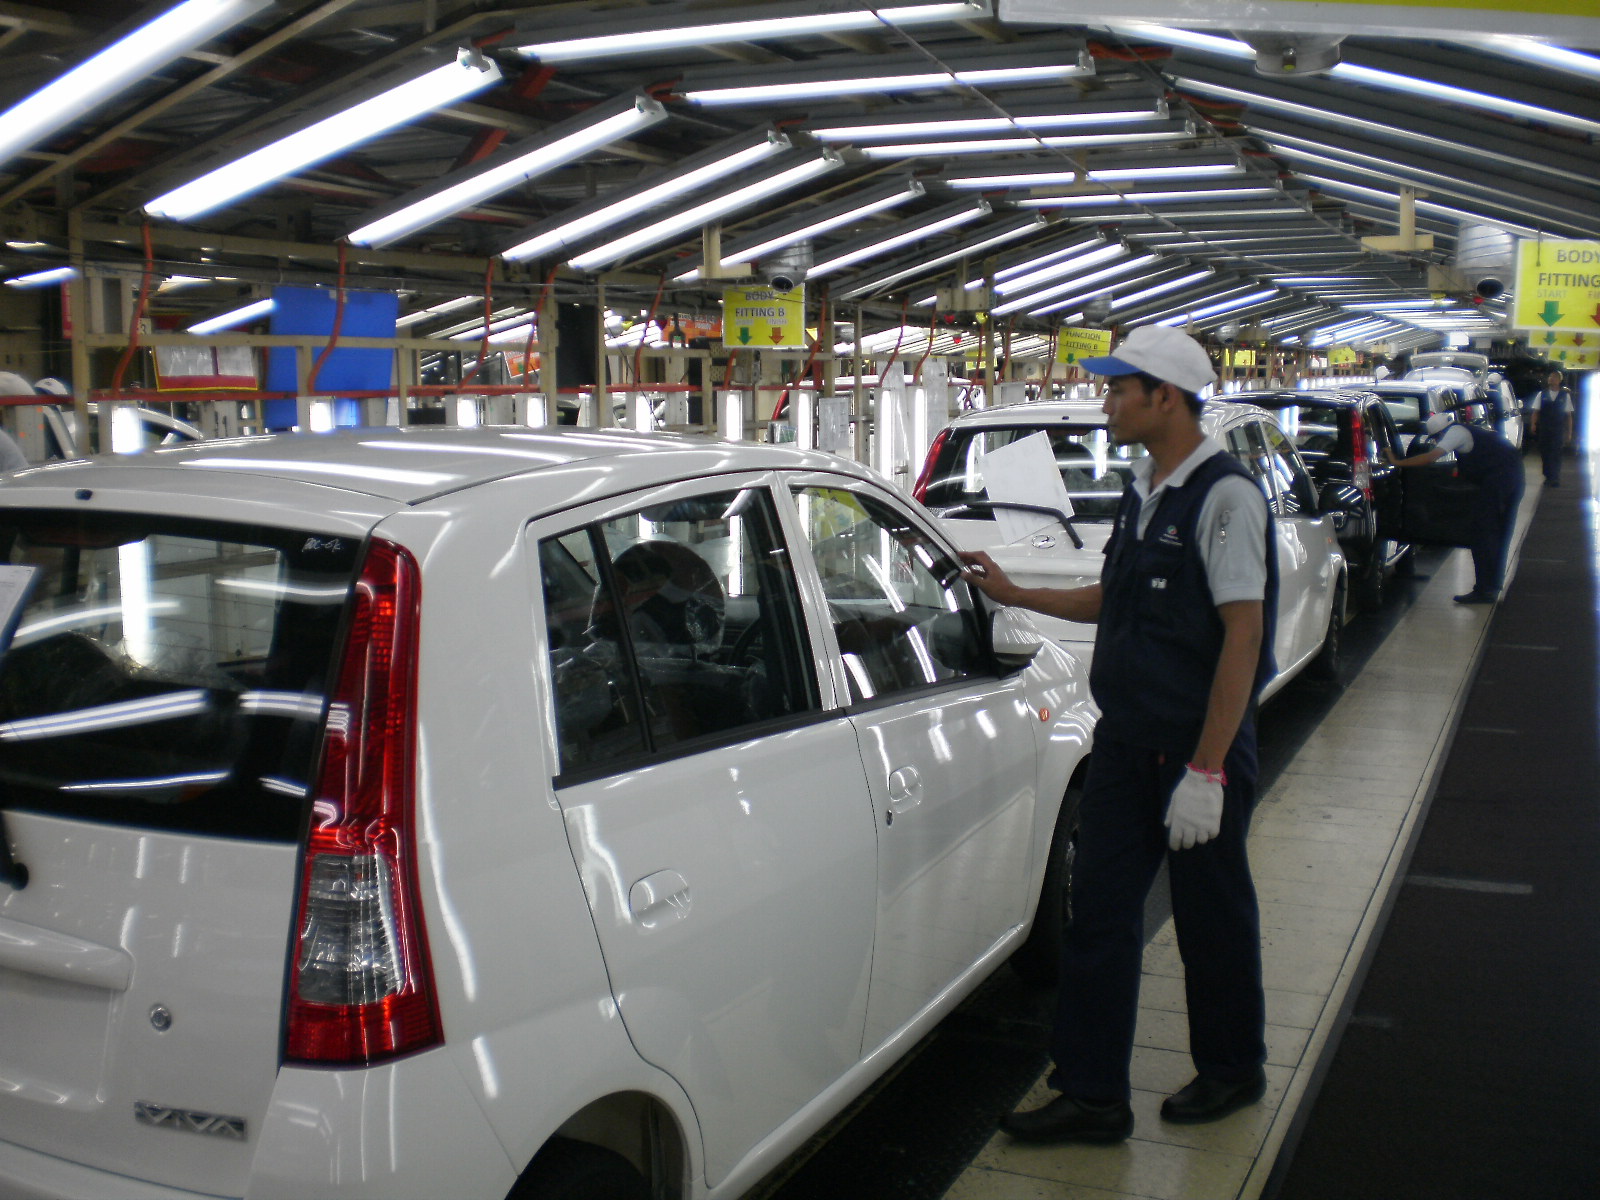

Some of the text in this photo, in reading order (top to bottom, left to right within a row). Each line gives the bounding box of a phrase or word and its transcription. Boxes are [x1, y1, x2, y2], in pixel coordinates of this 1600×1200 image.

[745, 290, 774, 301] BODY
[1537, 289, 1567, 298] START
[735, 307, 786, 317] FITTING B
[1066, 331, 1101, 341] FUNCTION
[1066, 340, 1092, 350] FITTING
[135, 1100, 247, 1141] VIVA
